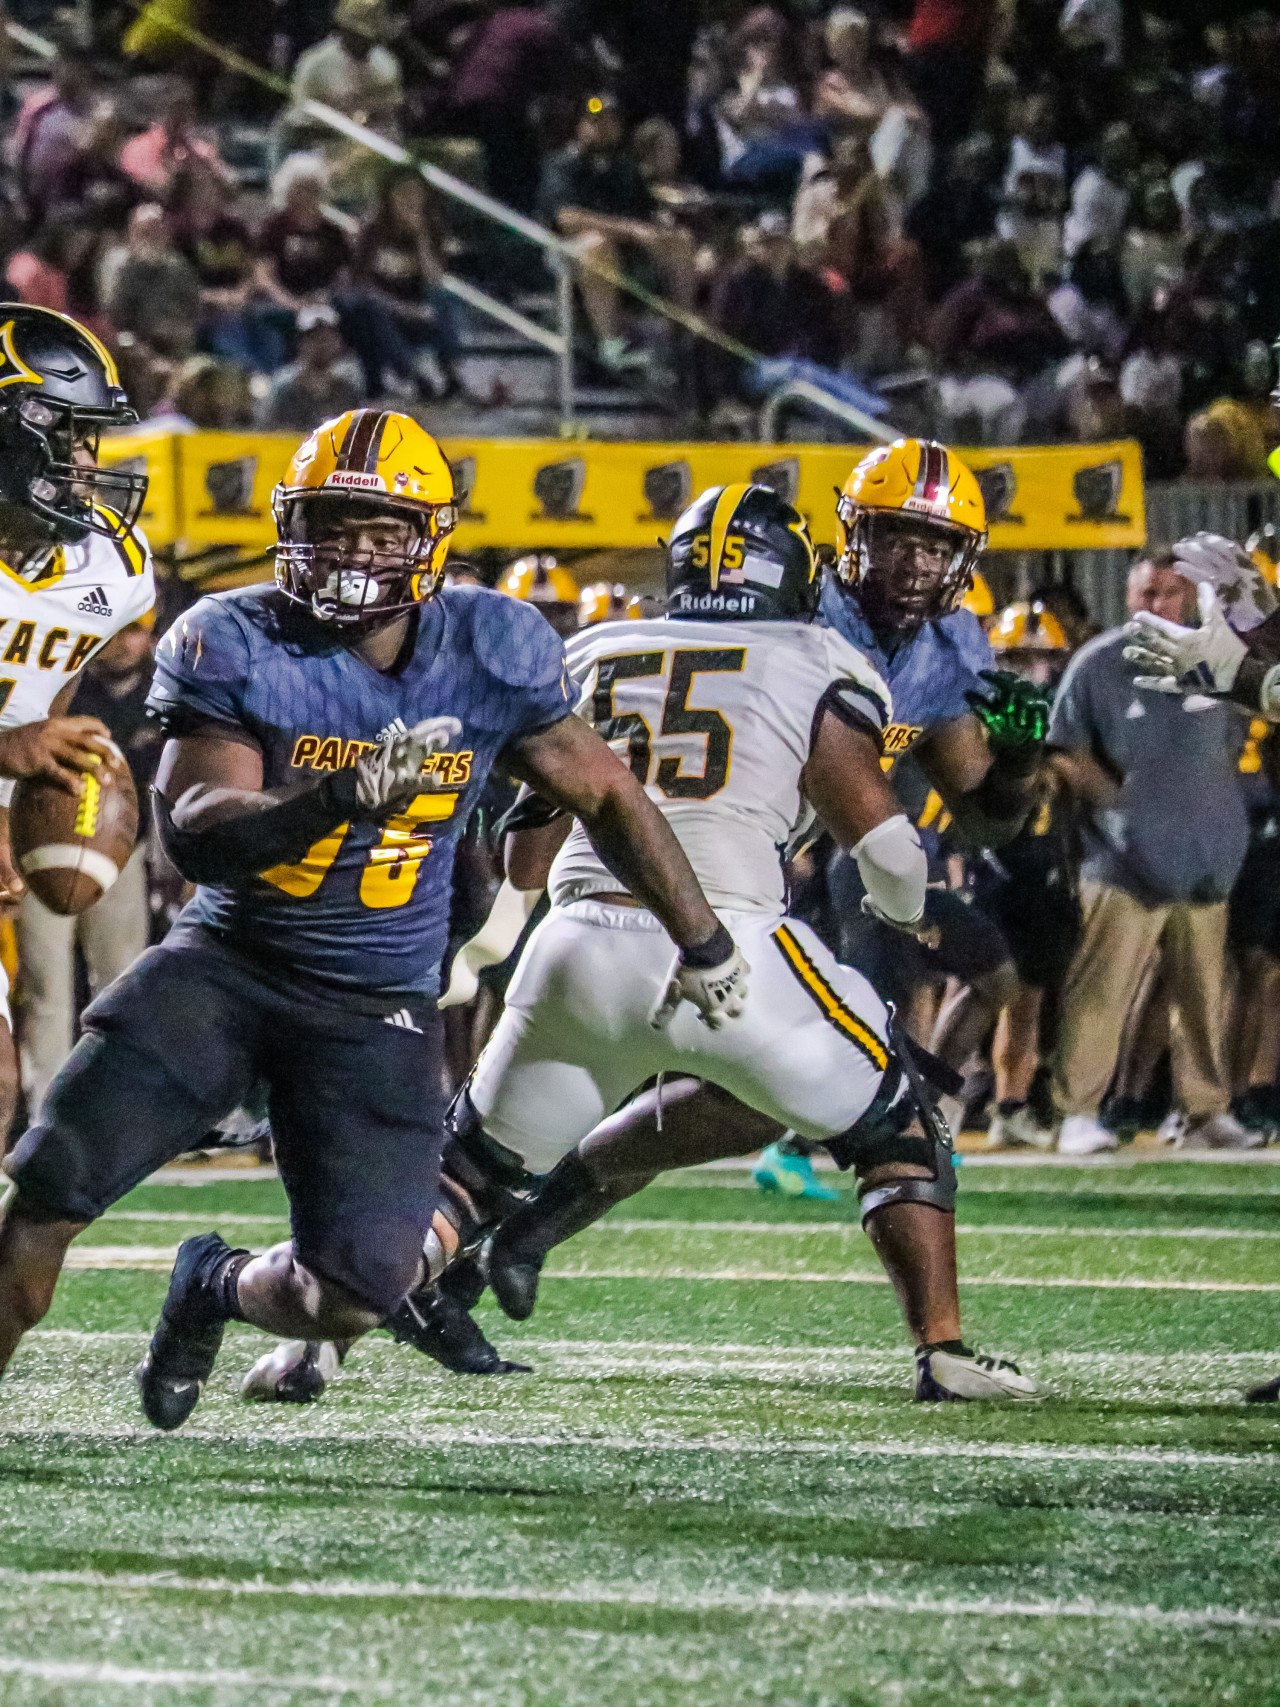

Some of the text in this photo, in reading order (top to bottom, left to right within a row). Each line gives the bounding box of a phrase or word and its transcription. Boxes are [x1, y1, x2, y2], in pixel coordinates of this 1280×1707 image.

[331, 473, 379, 487] Riddell
[691, 533, 745, 569] 55
[77, 601, 114, 618] adidas
[680, 593, 755, 613] Riddell
[592, 645, 747, 801] 55
[291, 735, 475, 786] PANERS
